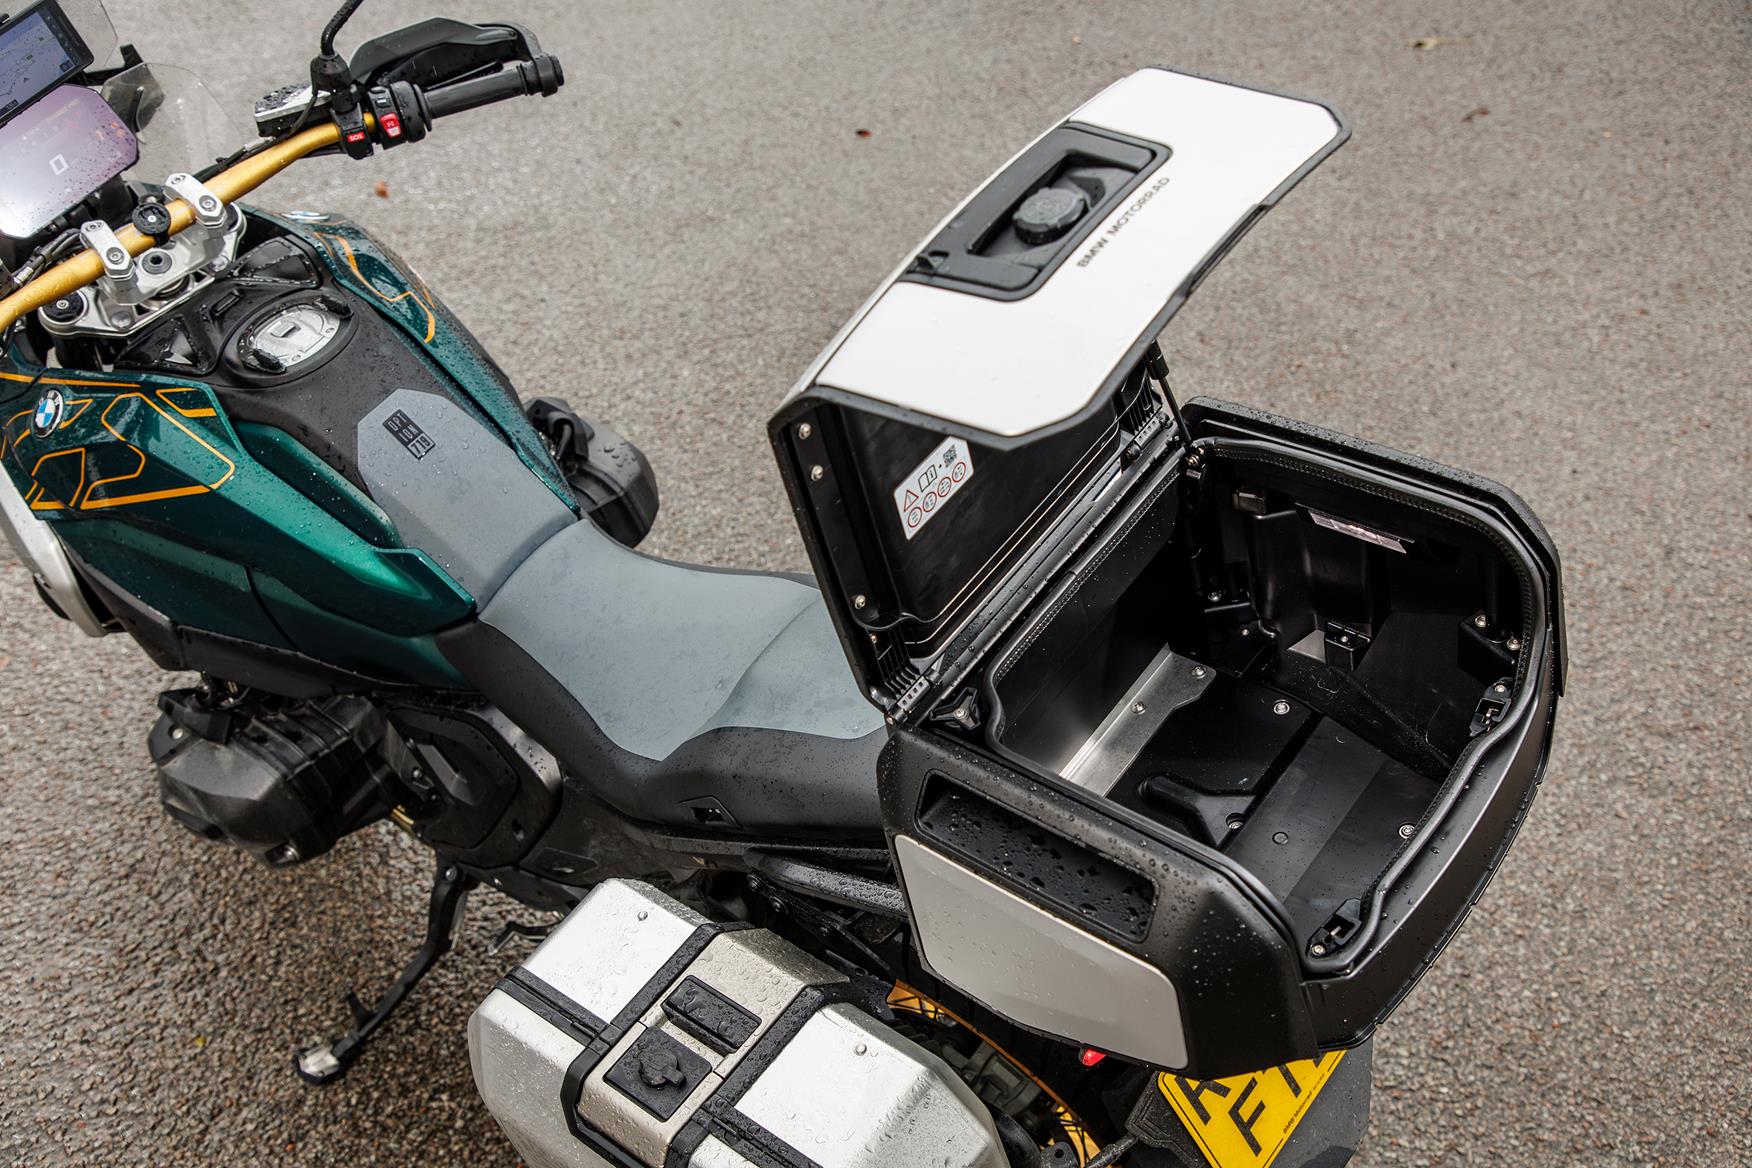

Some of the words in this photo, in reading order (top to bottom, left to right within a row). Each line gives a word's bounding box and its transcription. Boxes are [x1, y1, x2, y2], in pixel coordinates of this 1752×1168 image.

[1077, 238, 1108, 267] BMW
[1107, 178, 1170, 236] MOTORRAD
[411, 436, 431, 454] 719
